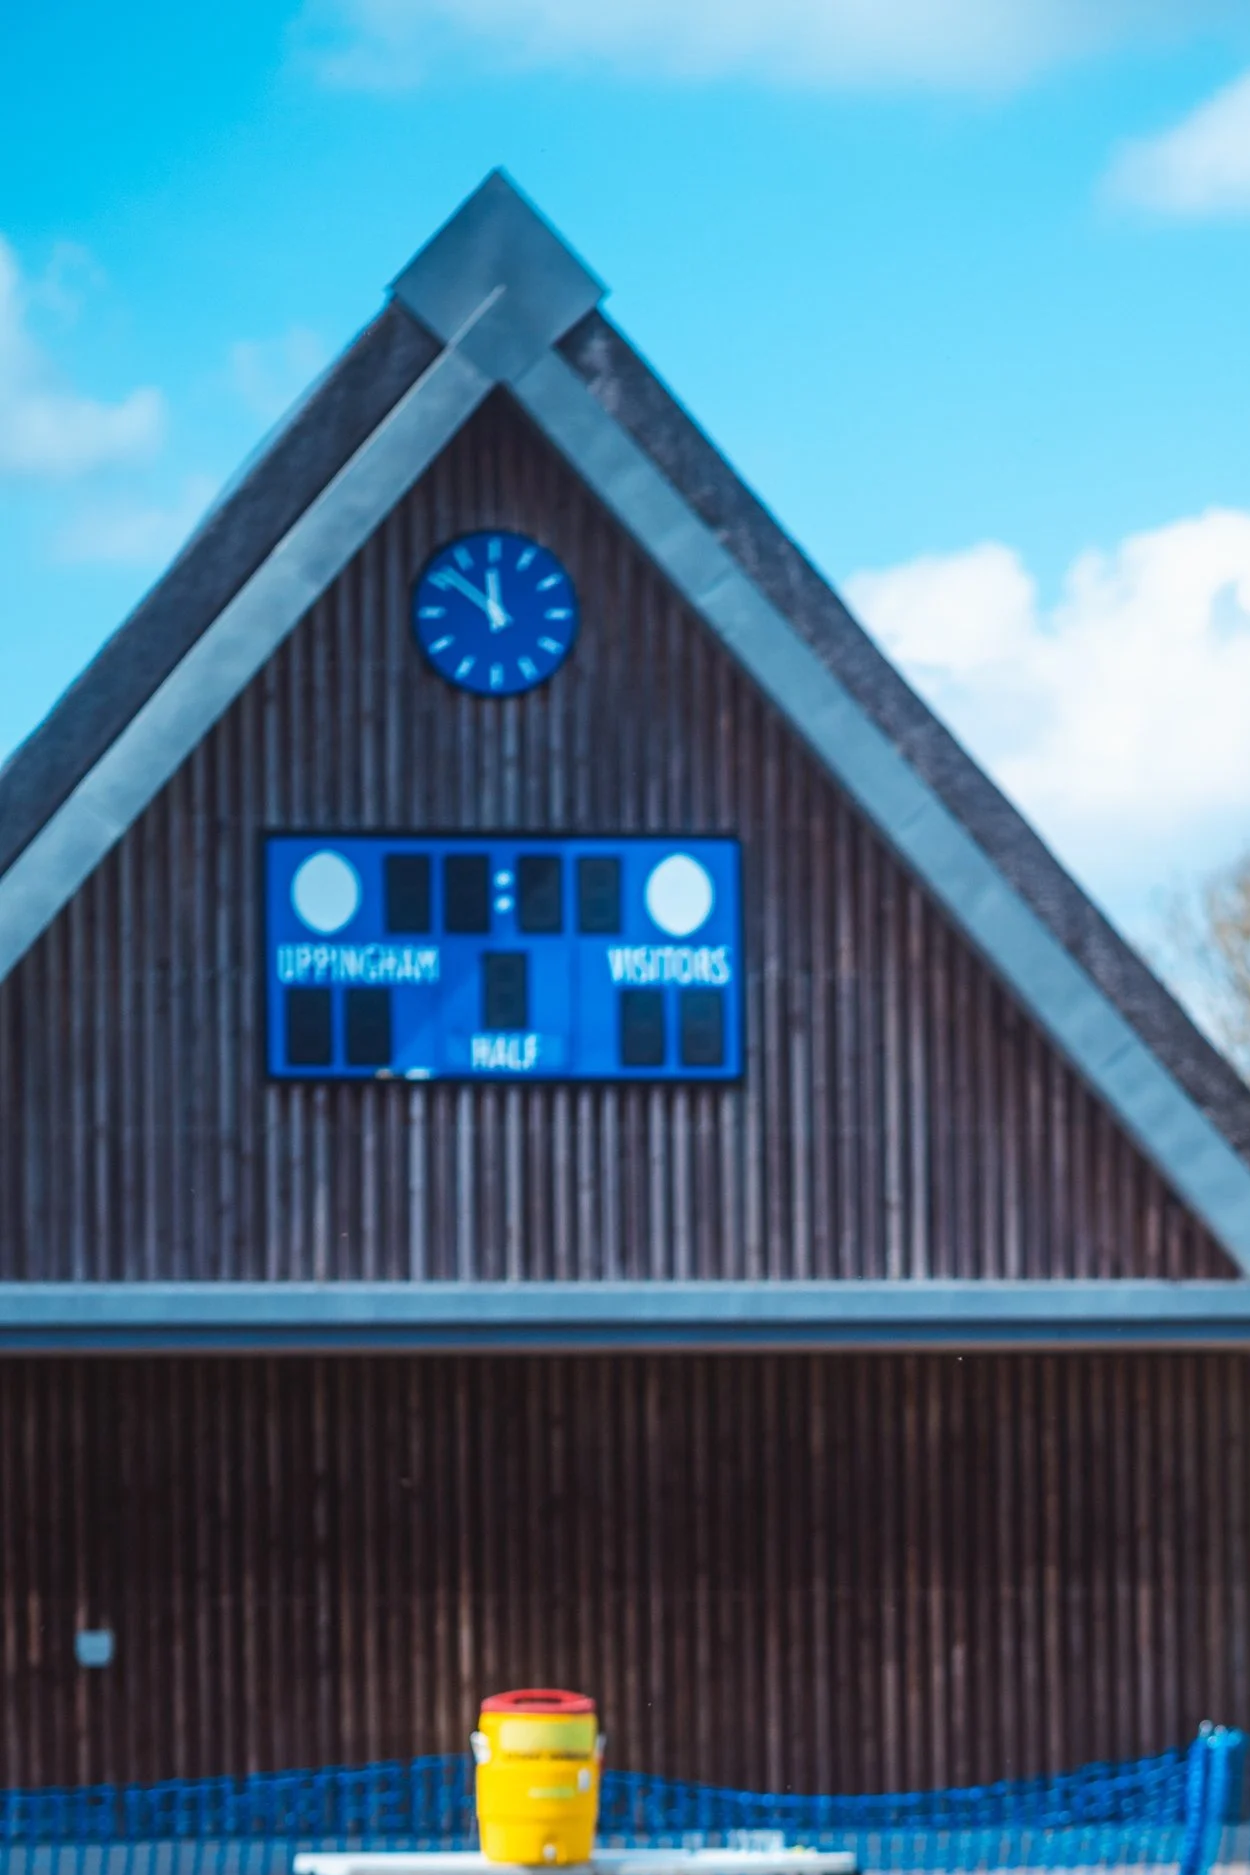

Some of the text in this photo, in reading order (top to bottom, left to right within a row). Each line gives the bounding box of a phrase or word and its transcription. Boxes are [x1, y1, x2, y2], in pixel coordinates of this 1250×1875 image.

[277, 944, 440, 984] UPPINGHAM
[608, 945, 730, 984] VISITORS
[471, 1034, 538, 1070] HALF
